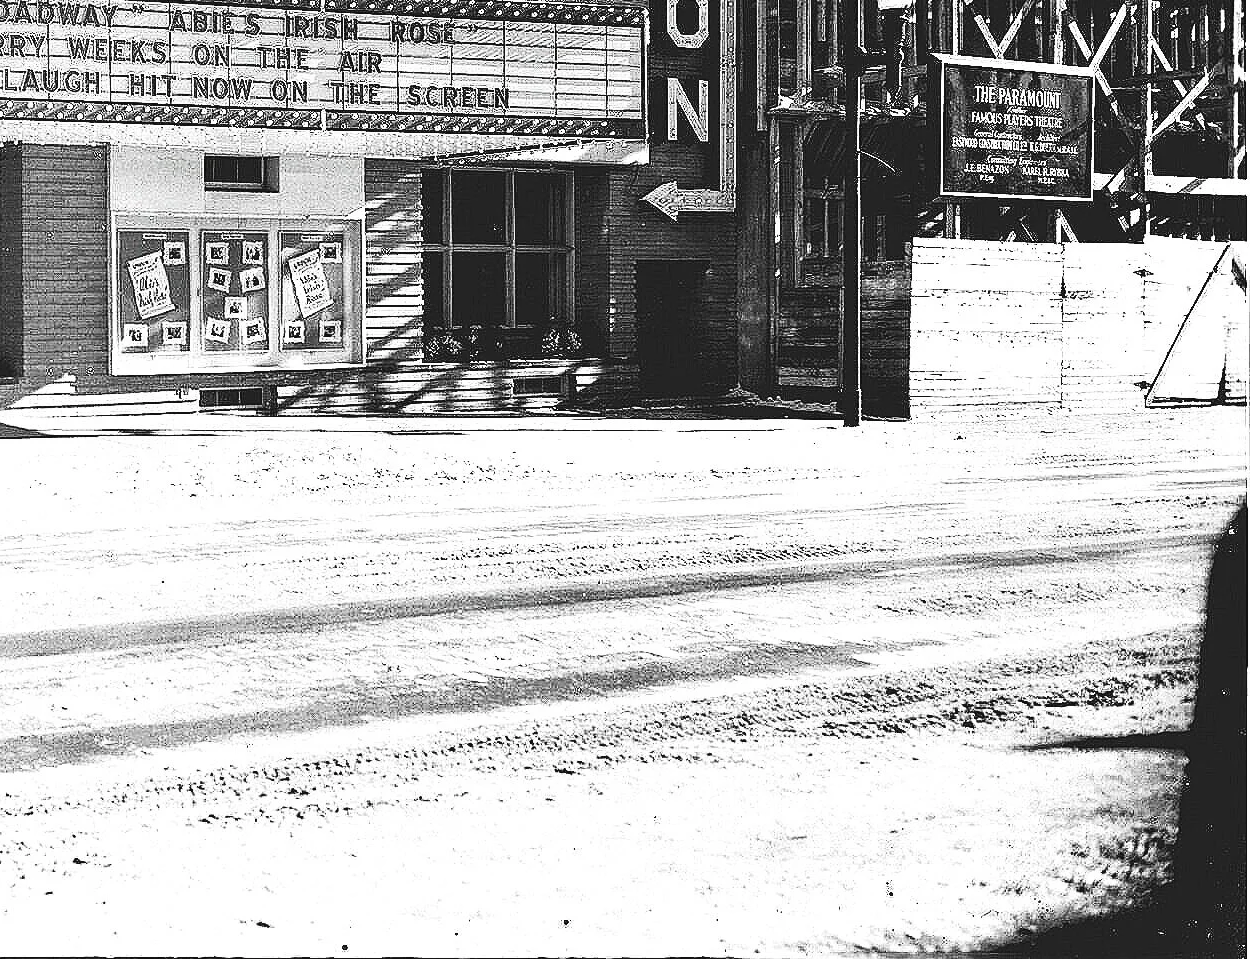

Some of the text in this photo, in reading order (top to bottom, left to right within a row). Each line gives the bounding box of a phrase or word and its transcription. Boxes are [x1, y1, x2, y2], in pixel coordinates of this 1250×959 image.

[286, 15, 358, 40] IRISH
[69, 36, 167, 64] WEEKS
[194, 43, 230, 67] ON
[257, 46, 309, 70] THE
[340, 50, 382, 73] AIR
[2, 68, 100, 94] LAUGH
[129, 73, 177, 97] HIT
[192, 76, 252, 101] NOW
[271, 79, 308, 102] ON
[330, 82, 381, 105] THE
[407, 84, 510, 109] SCREEN
[974, 85, 1062, 109] THE PARAMOUNT
[971, 111, 1002, 124] FAMOUS
[1003, 113, 1033, 127] PLAYERS
